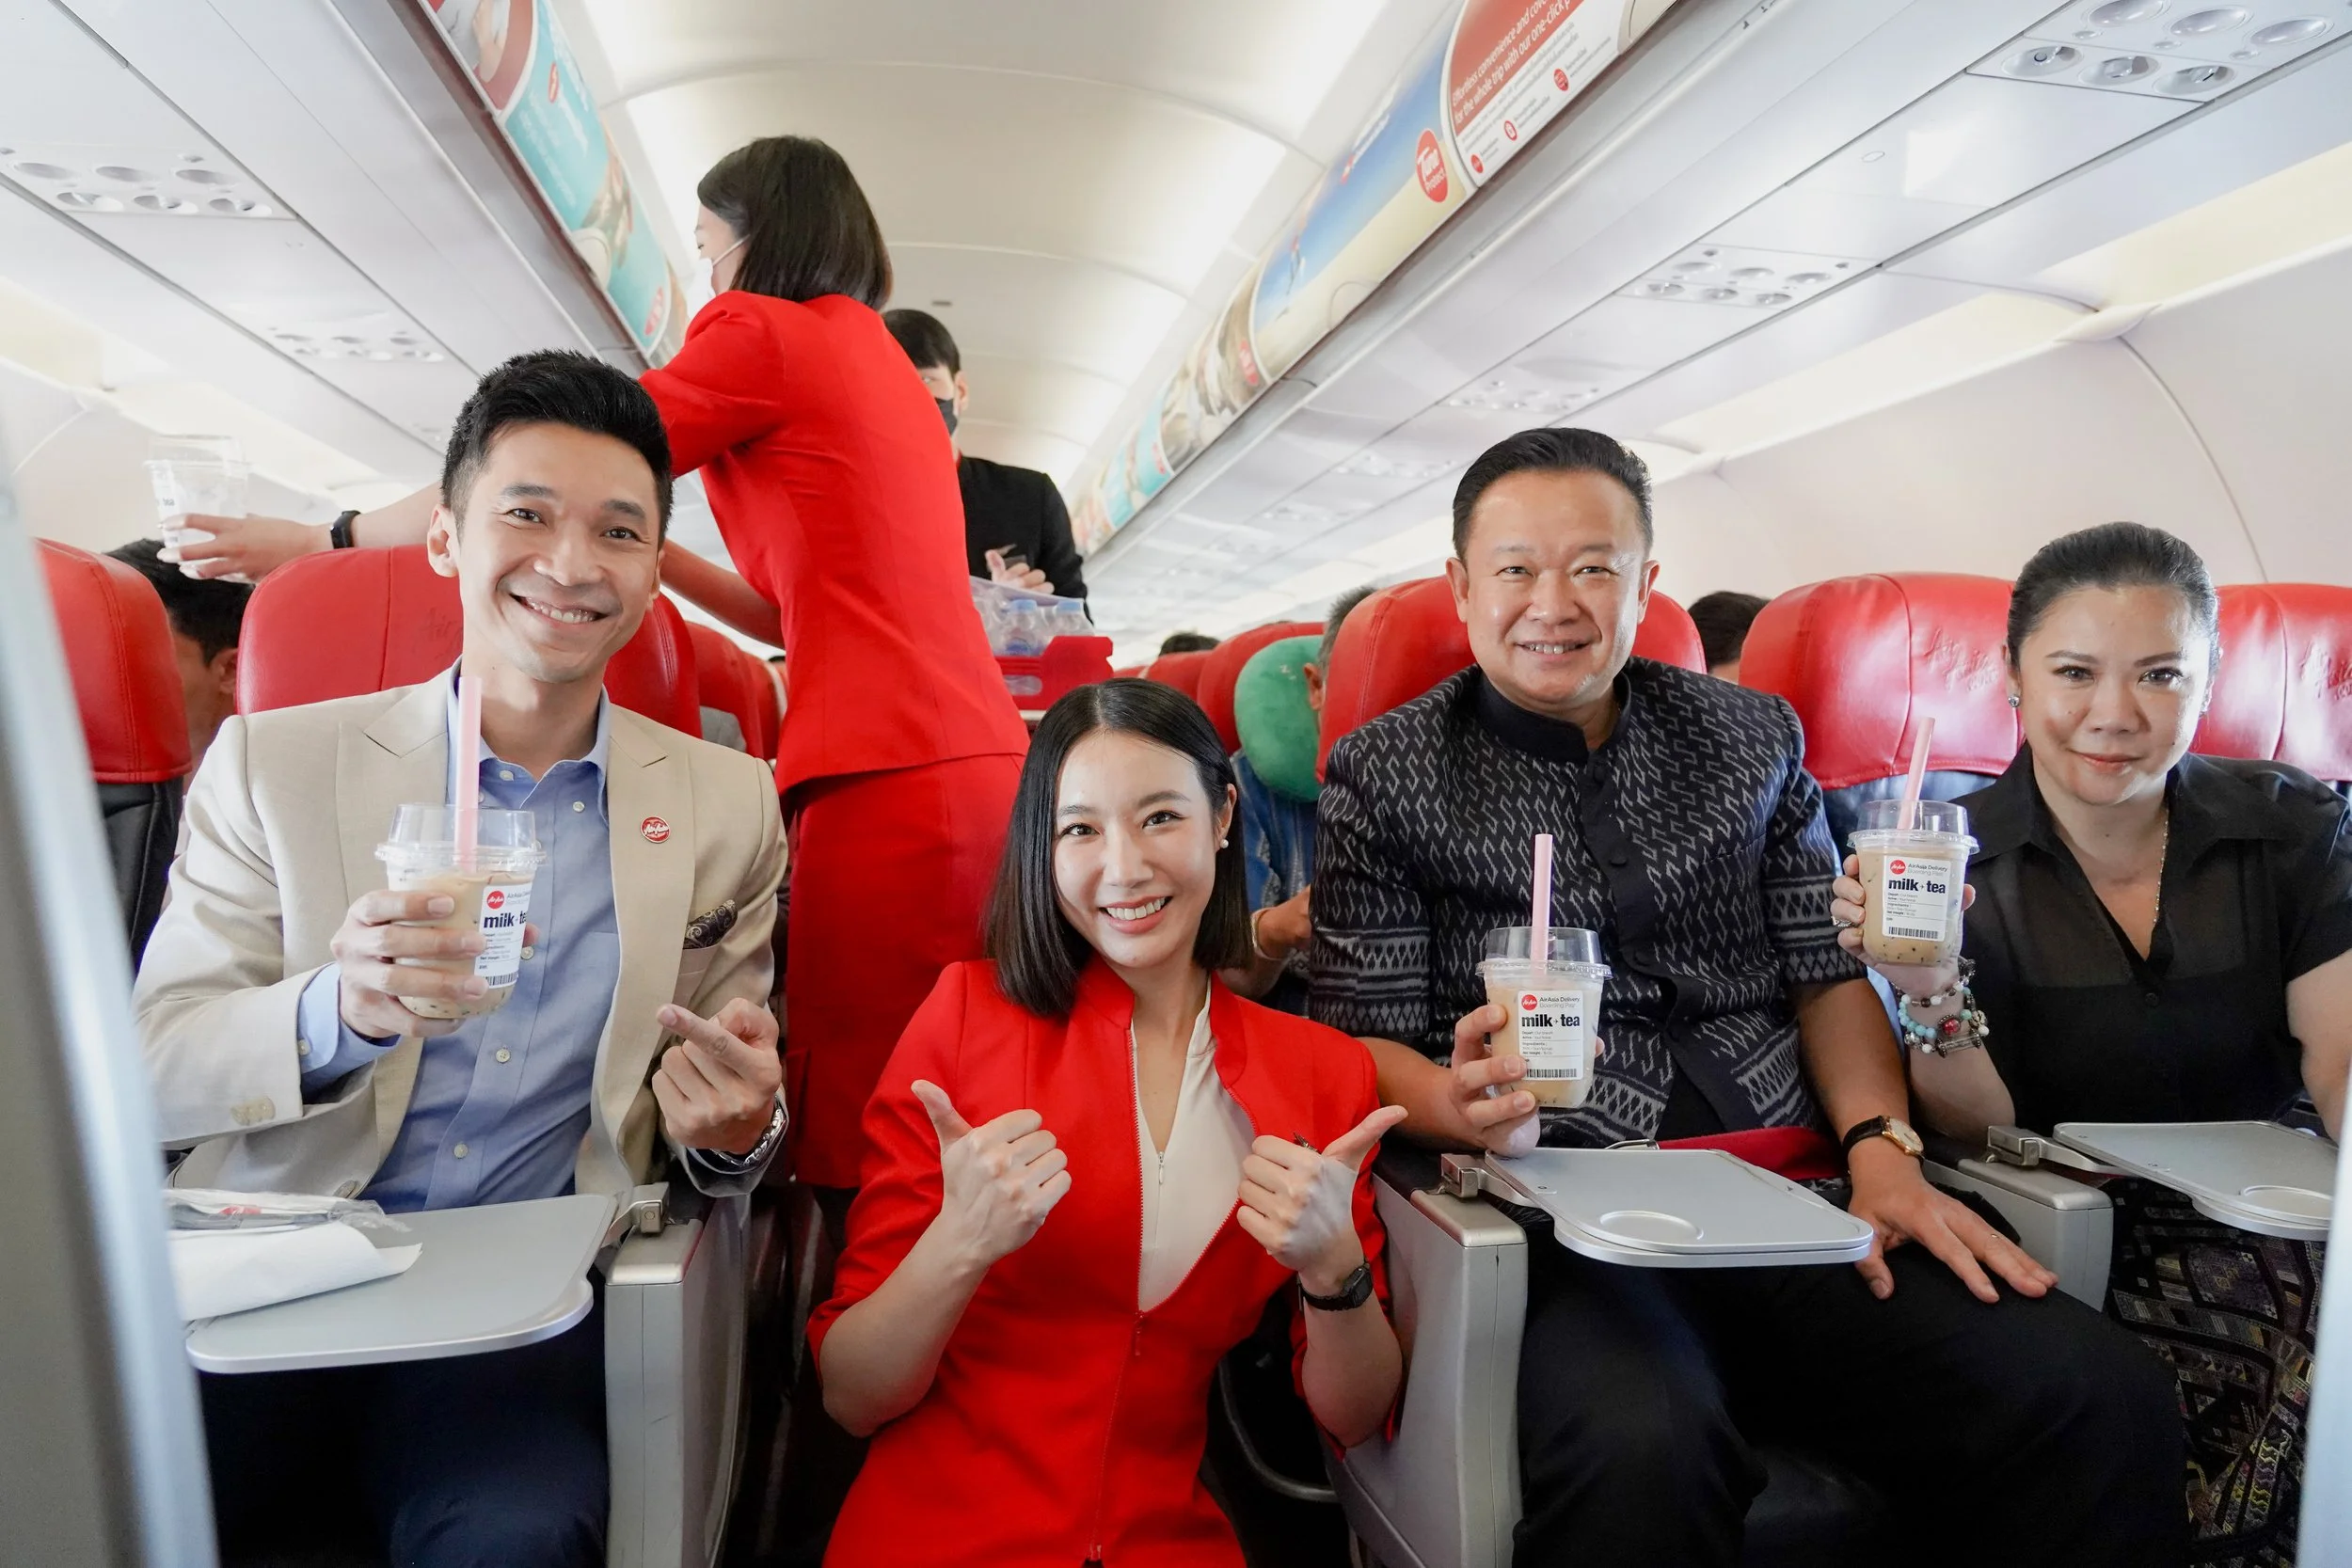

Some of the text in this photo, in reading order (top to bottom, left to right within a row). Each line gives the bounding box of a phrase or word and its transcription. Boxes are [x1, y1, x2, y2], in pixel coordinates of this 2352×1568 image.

[1517, 7, 1530, 34] and
[1503, 48, 1519, 71] with
[1518, 34, 1531, 55] our
[1888, 878, 1946, 895] milk tea
[484, 912, 515, 928] milk
[1521, 1013, 1581, 1027] milk tea
